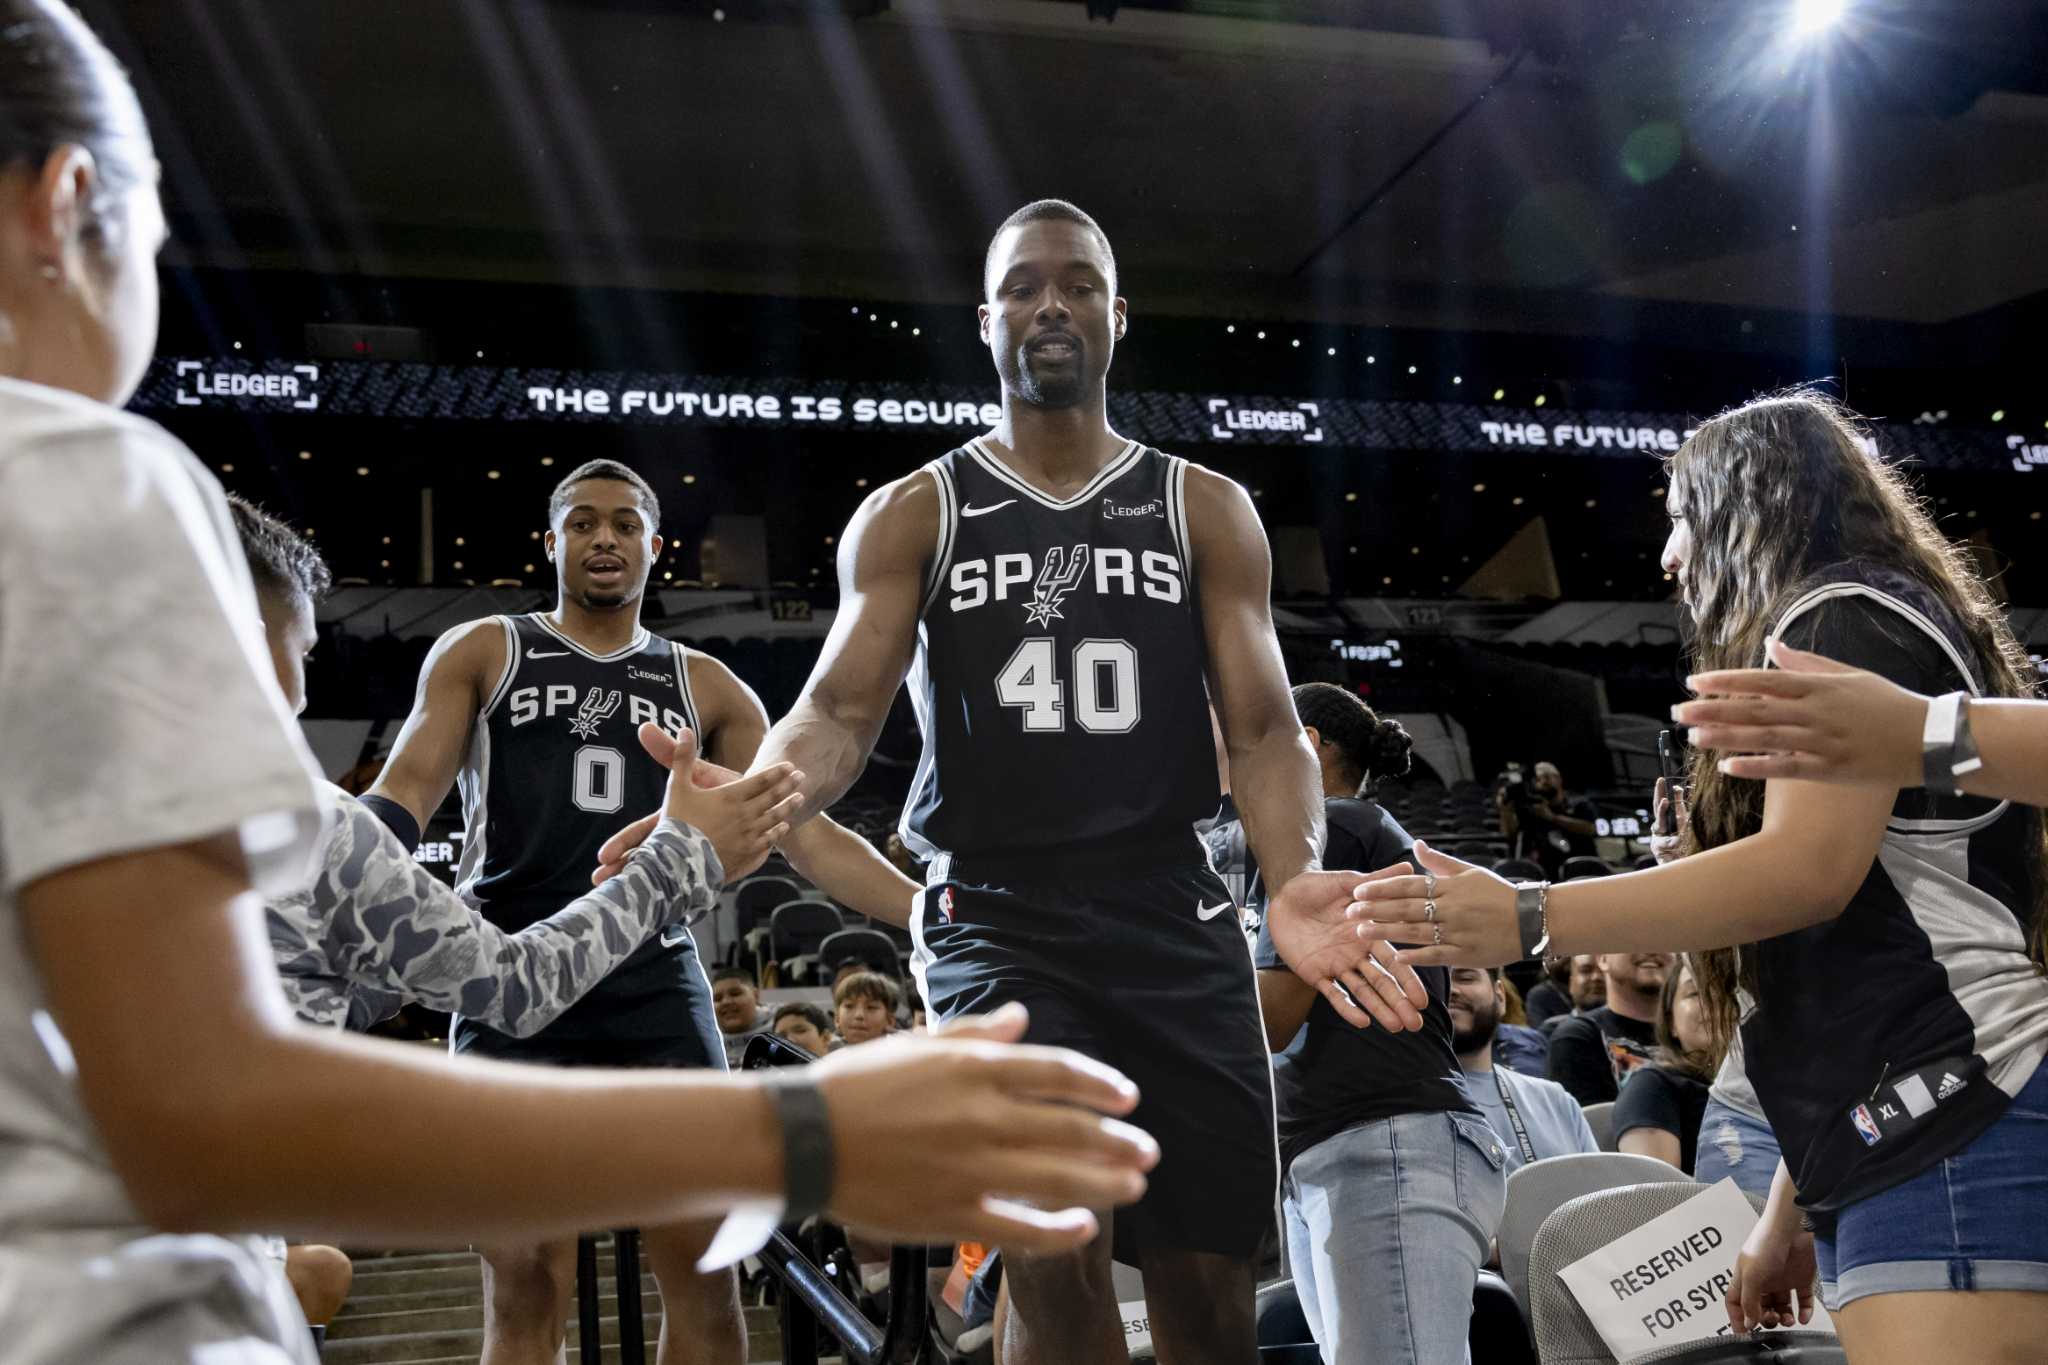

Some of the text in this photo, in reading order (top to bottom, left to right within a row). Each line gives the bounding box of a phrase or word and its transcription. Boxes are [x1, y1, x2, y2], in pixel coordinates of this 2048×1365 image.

[197, 372, 299, 397] LEDGER
[791, 396, 842, 421] IS
[1225, 409, 1307, 431] LEDGER
[1111, 503, 1156, 517] LEDGER
[950, 544, 1182, 630] SPURS
[994, 636, 1141, 734] 40
[572, 744, 626, 814] 0
[1878, 1103, 1899, 1120] XL
[1609, 1226, 1722, 1301] RESERVED
[1641, 1299, 1692, 1338] FOR
